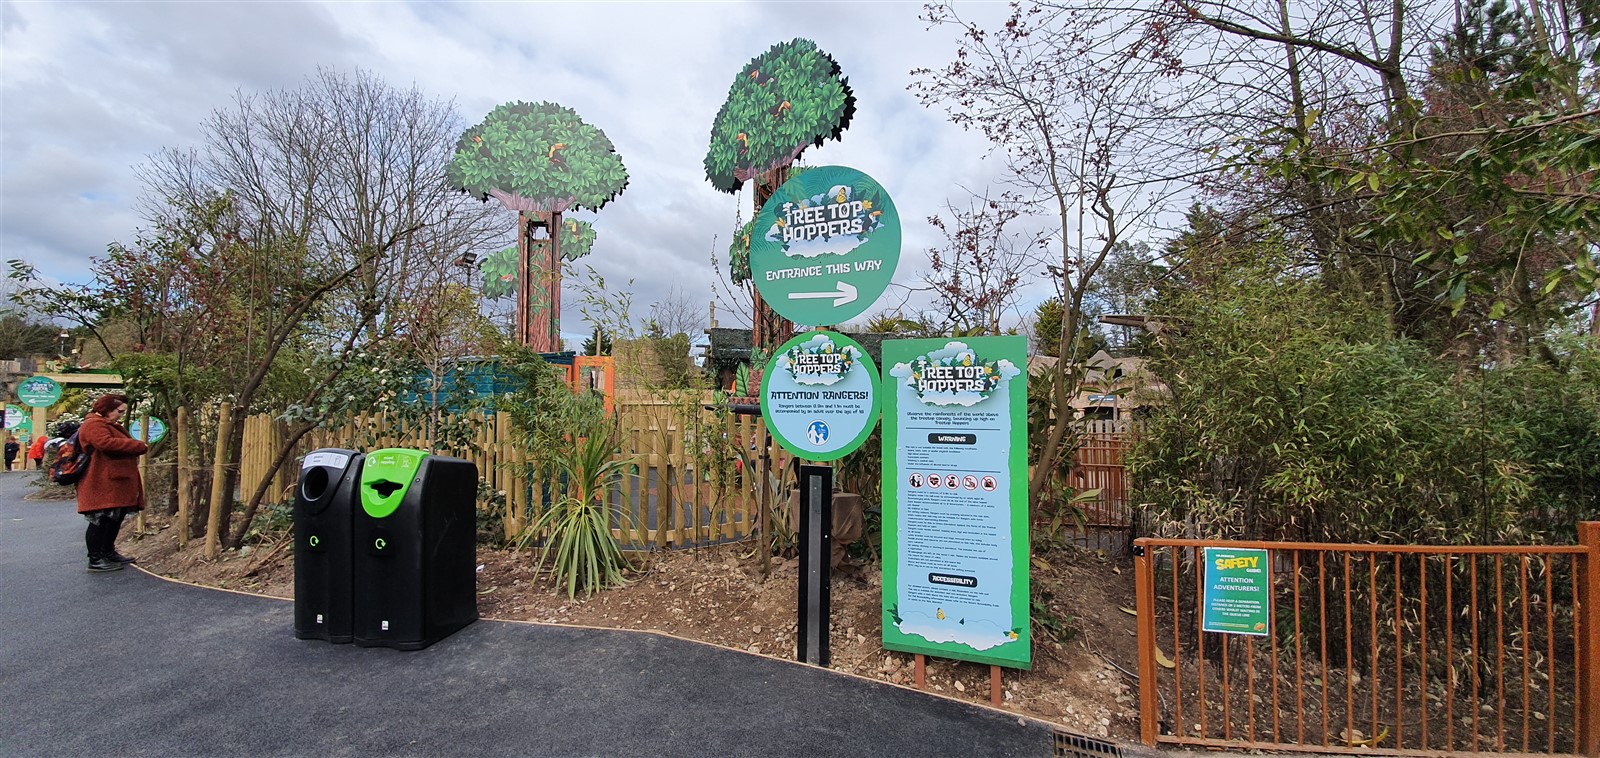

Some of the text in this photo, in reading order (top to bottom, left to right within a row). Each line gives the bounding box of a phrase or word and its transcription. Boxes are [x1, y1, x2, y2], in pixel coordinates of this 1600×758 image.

[783, 201, 862, 225] TREE TOP
[783, 219, 862, 242] HOPPERS
[766, 260, 882, 281] ENTRANCE THIS WAY
[793, 349, 841, 364] TREE TOP
[793, 364, 840, 374] HOPPERS
[918, 360, 984, 379] TREE TOP
[919, 380, 984, 392] HOPPERS
[771, 391, 868, 400] ATTENTION RANGERS!
[1215, 556, 1258, 570] SAFETY
[932, 576, 973, 585] ACCESSIBILITY
